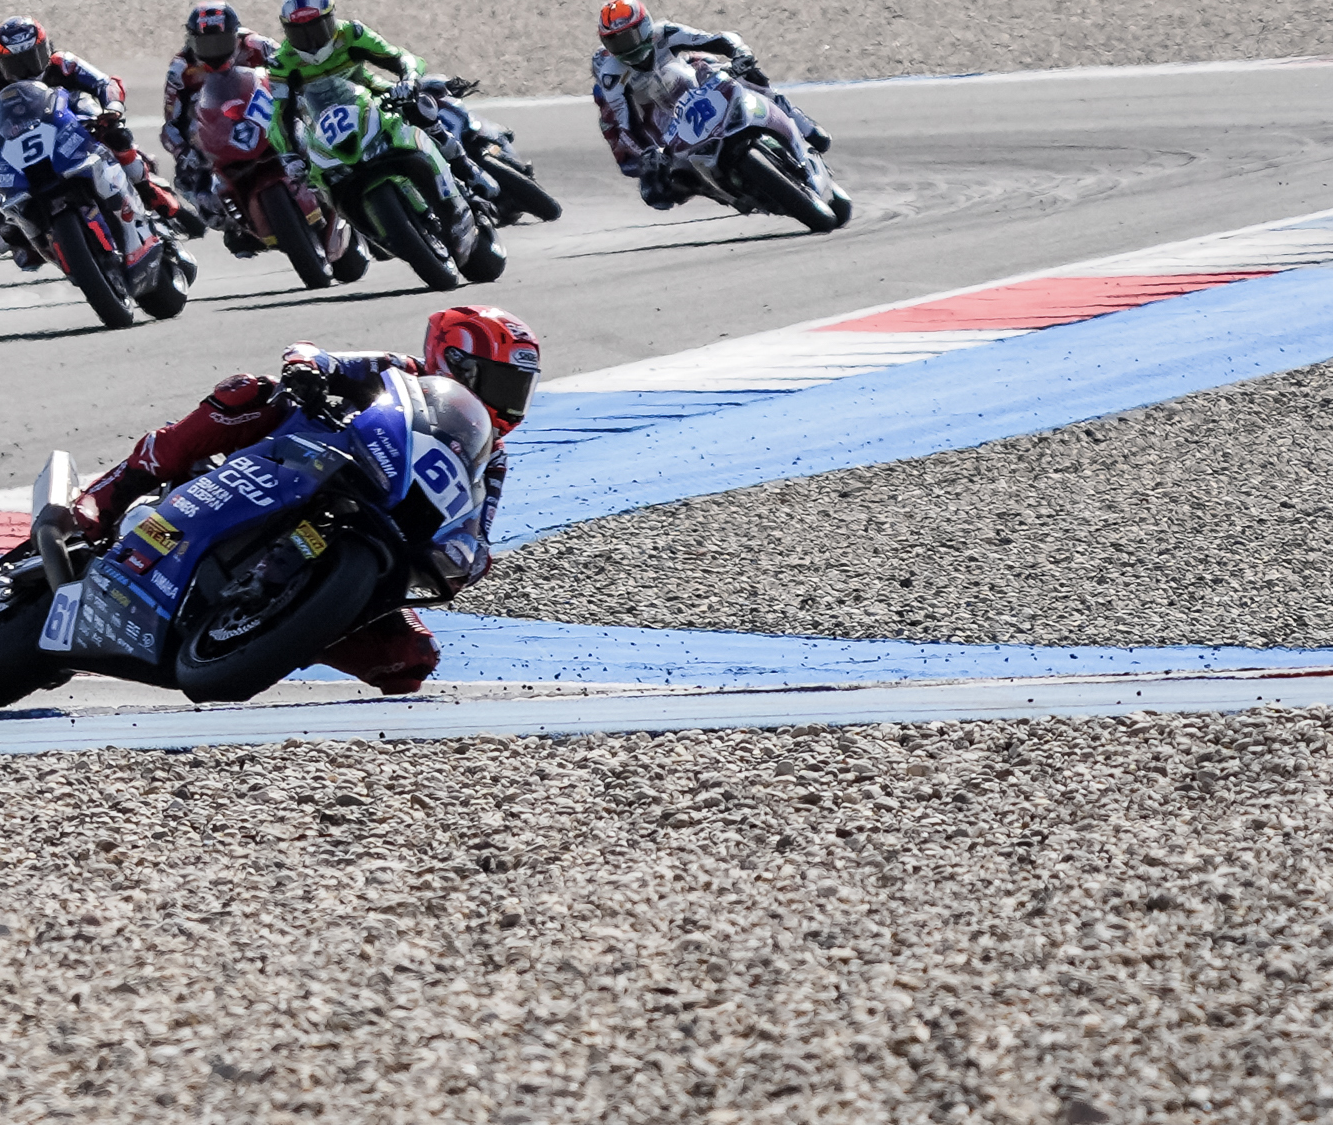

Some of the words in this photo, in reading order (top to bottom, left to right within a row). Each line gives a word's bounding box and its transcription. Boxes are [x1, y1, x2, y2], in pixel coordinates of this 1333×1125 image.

[319, 106, 355, 146] 52
[685, 97, 718, 138] 28
[21, 132, 45, 164] 5
[366, 440, 398, 479] YAMAHA
[413, 447, 470, 519] 61
[44, 592, 78, 645] 61
